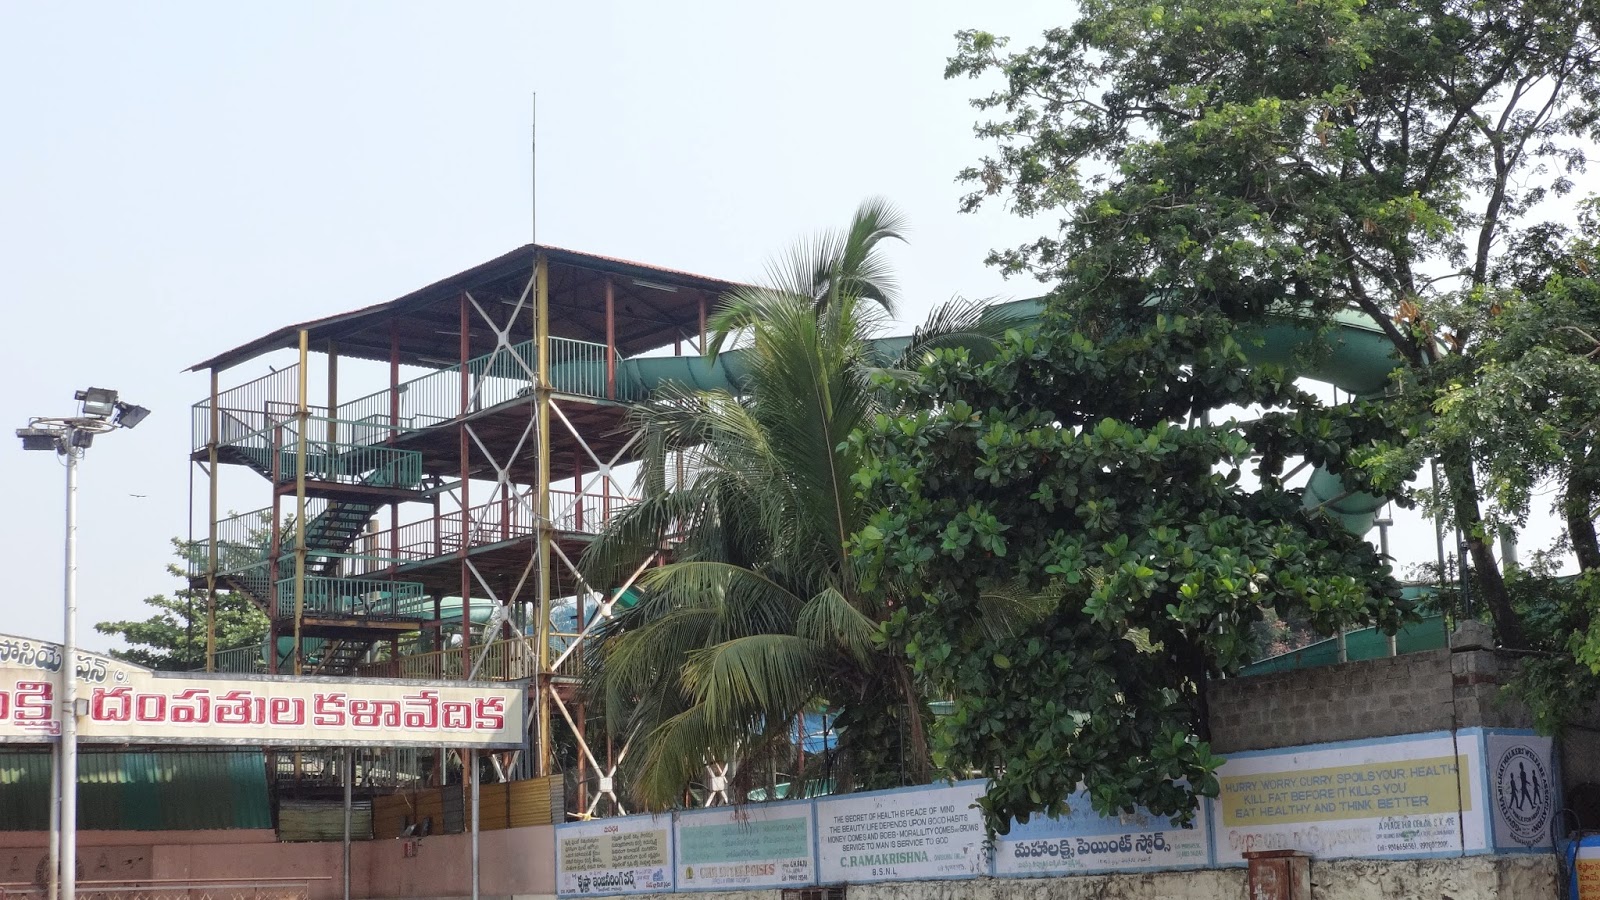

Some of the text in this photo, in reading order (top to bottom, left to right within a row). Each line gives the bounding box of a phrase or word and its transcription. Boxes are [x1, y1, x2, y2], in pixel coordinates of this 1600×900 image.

[91, 686, 305, 725] దంపతుల
[314, 690, 504, 730] కళావేదిక
[1226, 781, 1257, 792] HURRY
[1260, 778, 1297, 790] WORRY
[1337, 771, 1376, 783] SPOILS
[1410, 764, 1458, 777] HEALTH
[1244, 782, 1406, 805] KILL FAT BEFORE IT KILLS YOU
[834, 815, 844, 823] THE
[845, 813, 868, 823] SECRET
[869, 812, 876, 820] OF
[877, 810, 899, 819] HEALTH
[906, 807, 927, 817] PEACE
[929, 807, 937, 815] OF
[940, 804, 955, 813] MIND
[1236, 795, 1429, 818] EAT HEALTHY AND THINK BETTER
[827, 835, 847, 844] MONEY
[847, 833, 867, 842] COMES
[867, 832, 879, 840] AND
[934, 825, 955, 835] COMES
[829, 814, 968, 834] THE BEAUTY LIFE DEPENDS UPON GOOD HABITS
[842, 842, 866, 852] SERVICE
[867, 842, 875, 850] TO
[876, 841, 890, 849] MAN
[897, 838, 924, 848] SERVICE
[925, 837, 934, 845] TO
[935, 836, 949, 844] GOD
